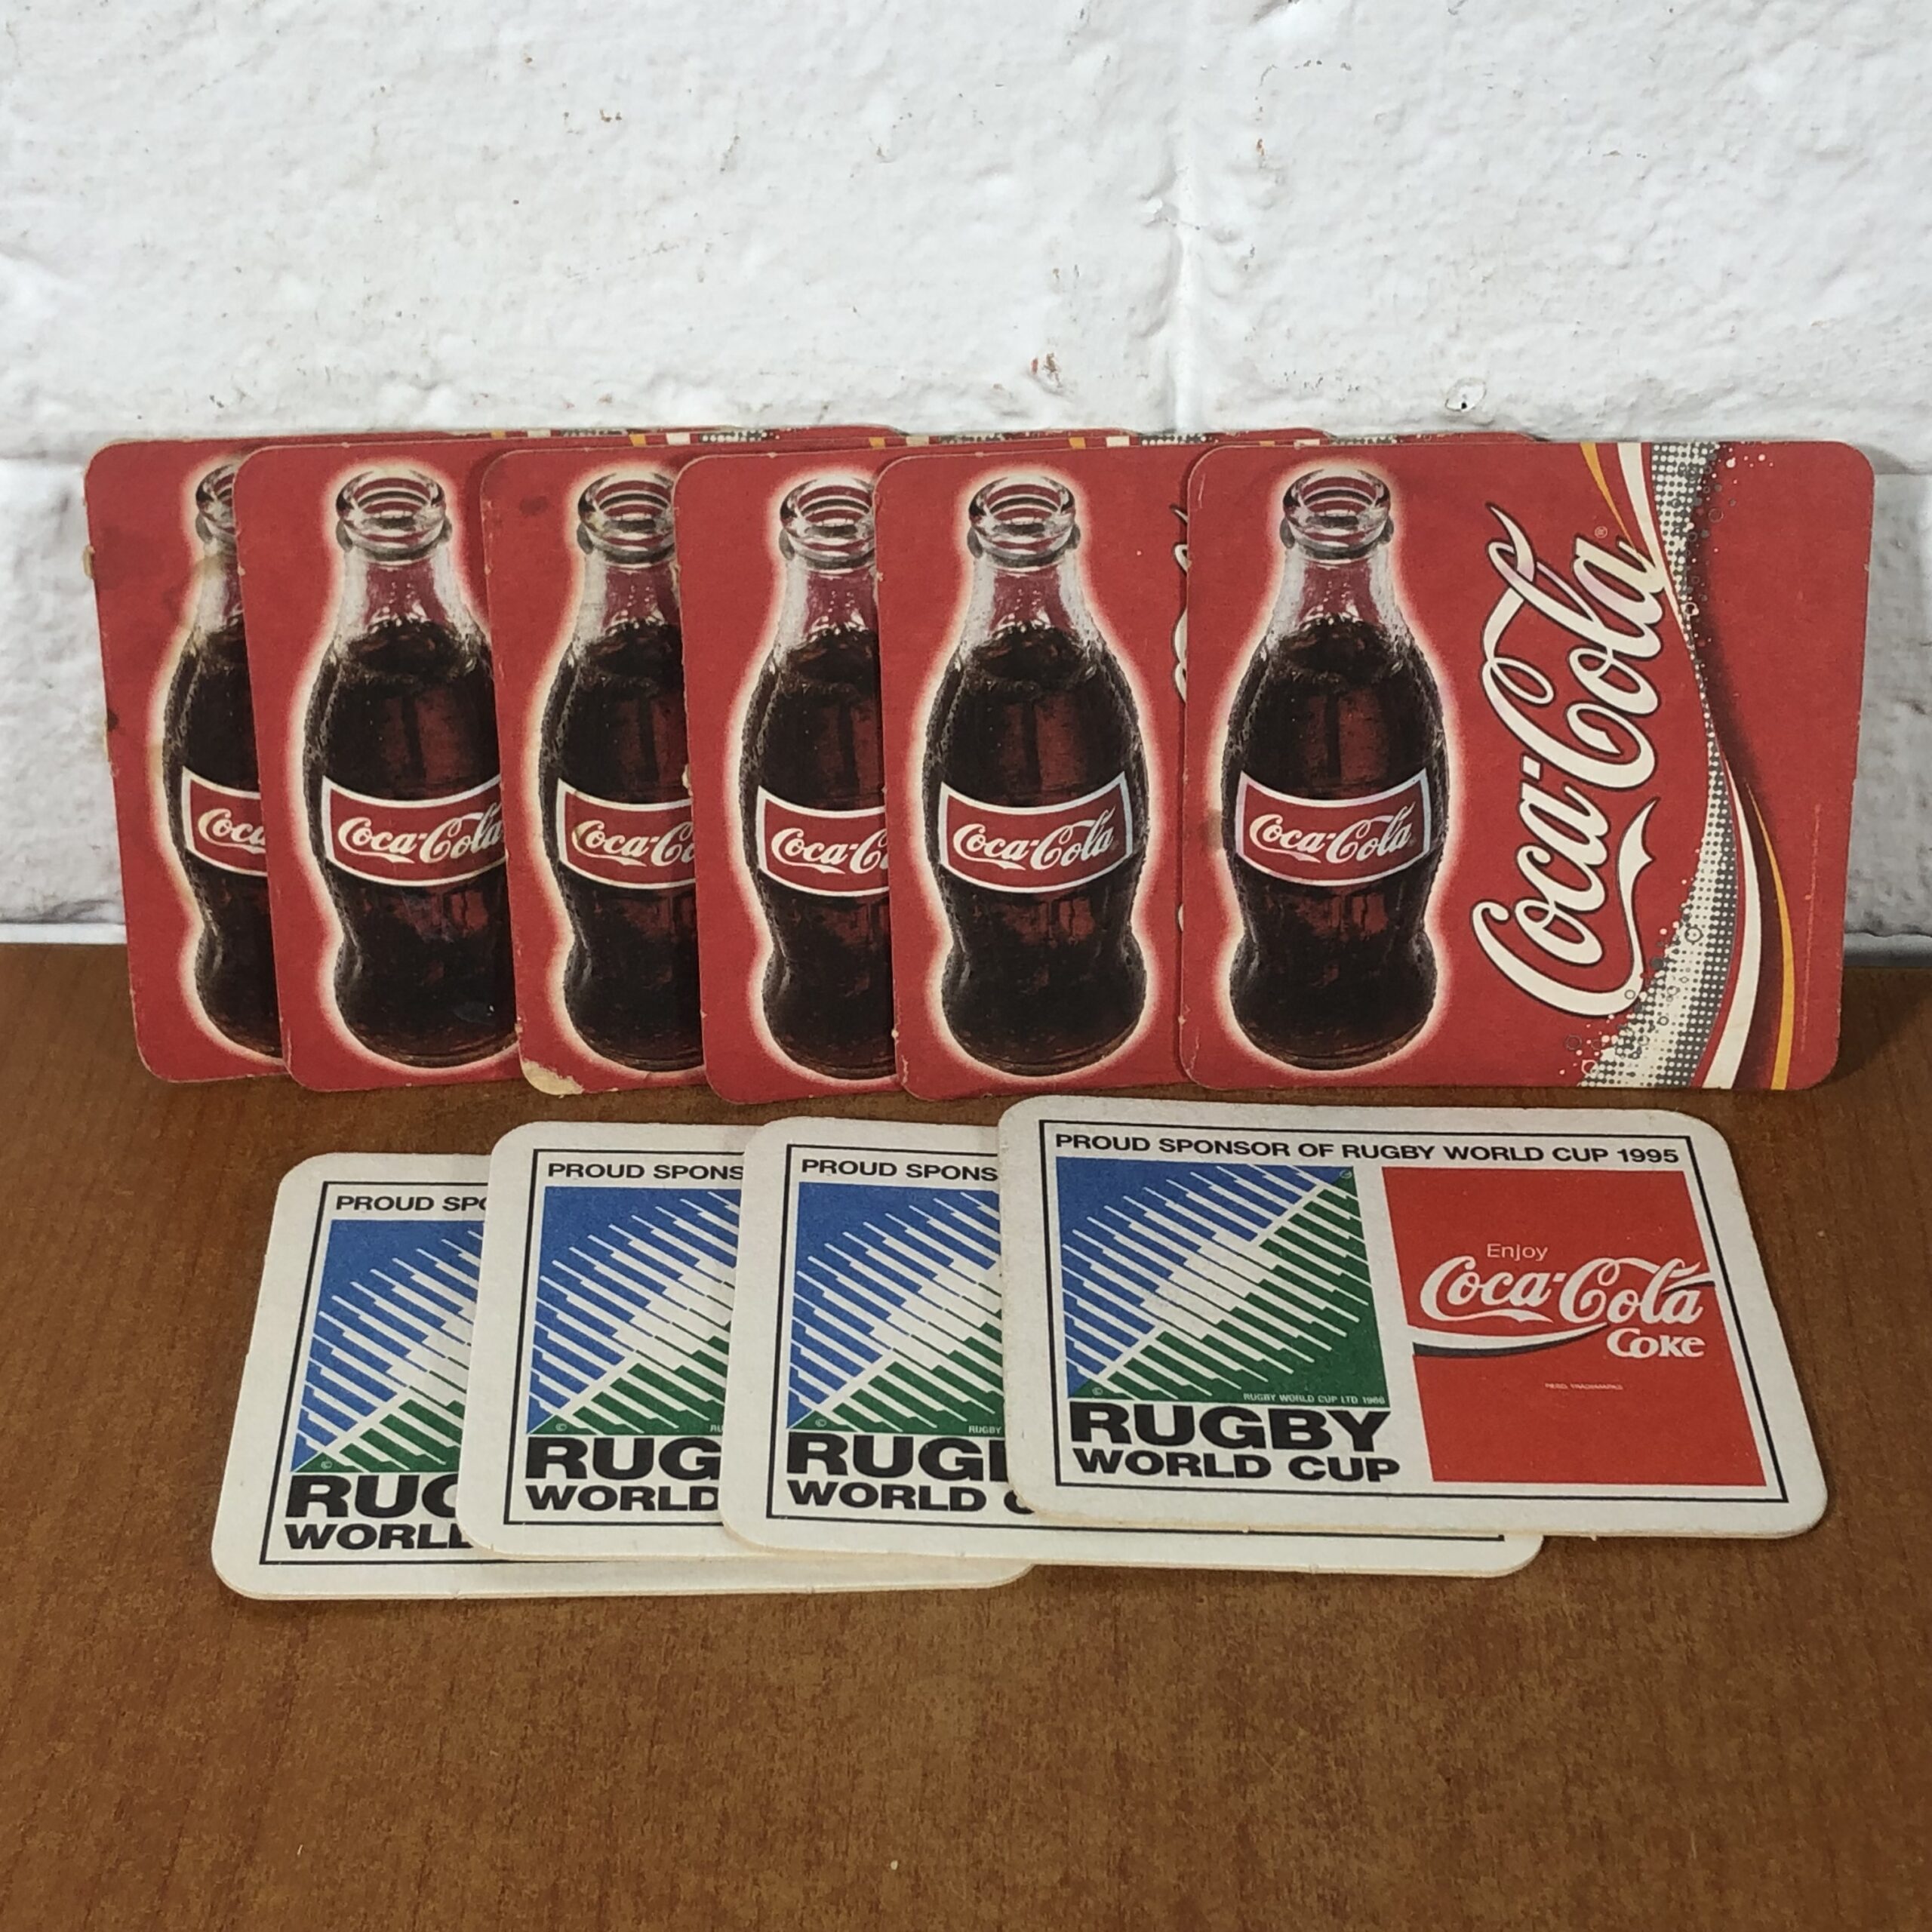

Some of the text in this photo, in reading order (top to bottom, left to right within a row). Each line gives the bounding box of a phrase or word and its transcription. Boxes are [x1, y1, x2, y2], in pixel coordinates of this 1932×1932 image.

[1472, 505, 1666, 1017] Coca-Cola
[952, 804, 1116, 870] Coca-Cola
[1249, 801, 1417, 864] Coca-Cola
[1056, 1134, 1680, 1164] PROUD SPONSOR OF RUGBY WORLD CUP 1995
[548, 1163, 645, 1178] PROUD
[801, 1158, 998, 1182] PROUD SPONS
[336, 1195, 435, 1211] PROUD
[1487, 1243, 1549, 1262] Enjoy
[1420, 1256, 1703, 1324] Coca-Cola
[1606, 1327, 1706, 1358] Coke
[1243, 1392, 1275, 1401] RUGBY
[1279, 1394, 1315, 1404] WORLD
[1318, 1395, 1338, 1404] CUP
[1341, 1395, 1358, 1404] LTD
[968, 1425, 1002, 1434] RUGBY
[1069, 1401, 1391, 1453] RUGBY
[525, 1436, 722, 1481] RUG
[786, 1431, 1009, 1482] RUG
[1072, 1447, 1401, 1483] WORLD CUP
[525, 1484, 719, 1512] WORLD
[787, 1479, 987, 1512] WORLD
